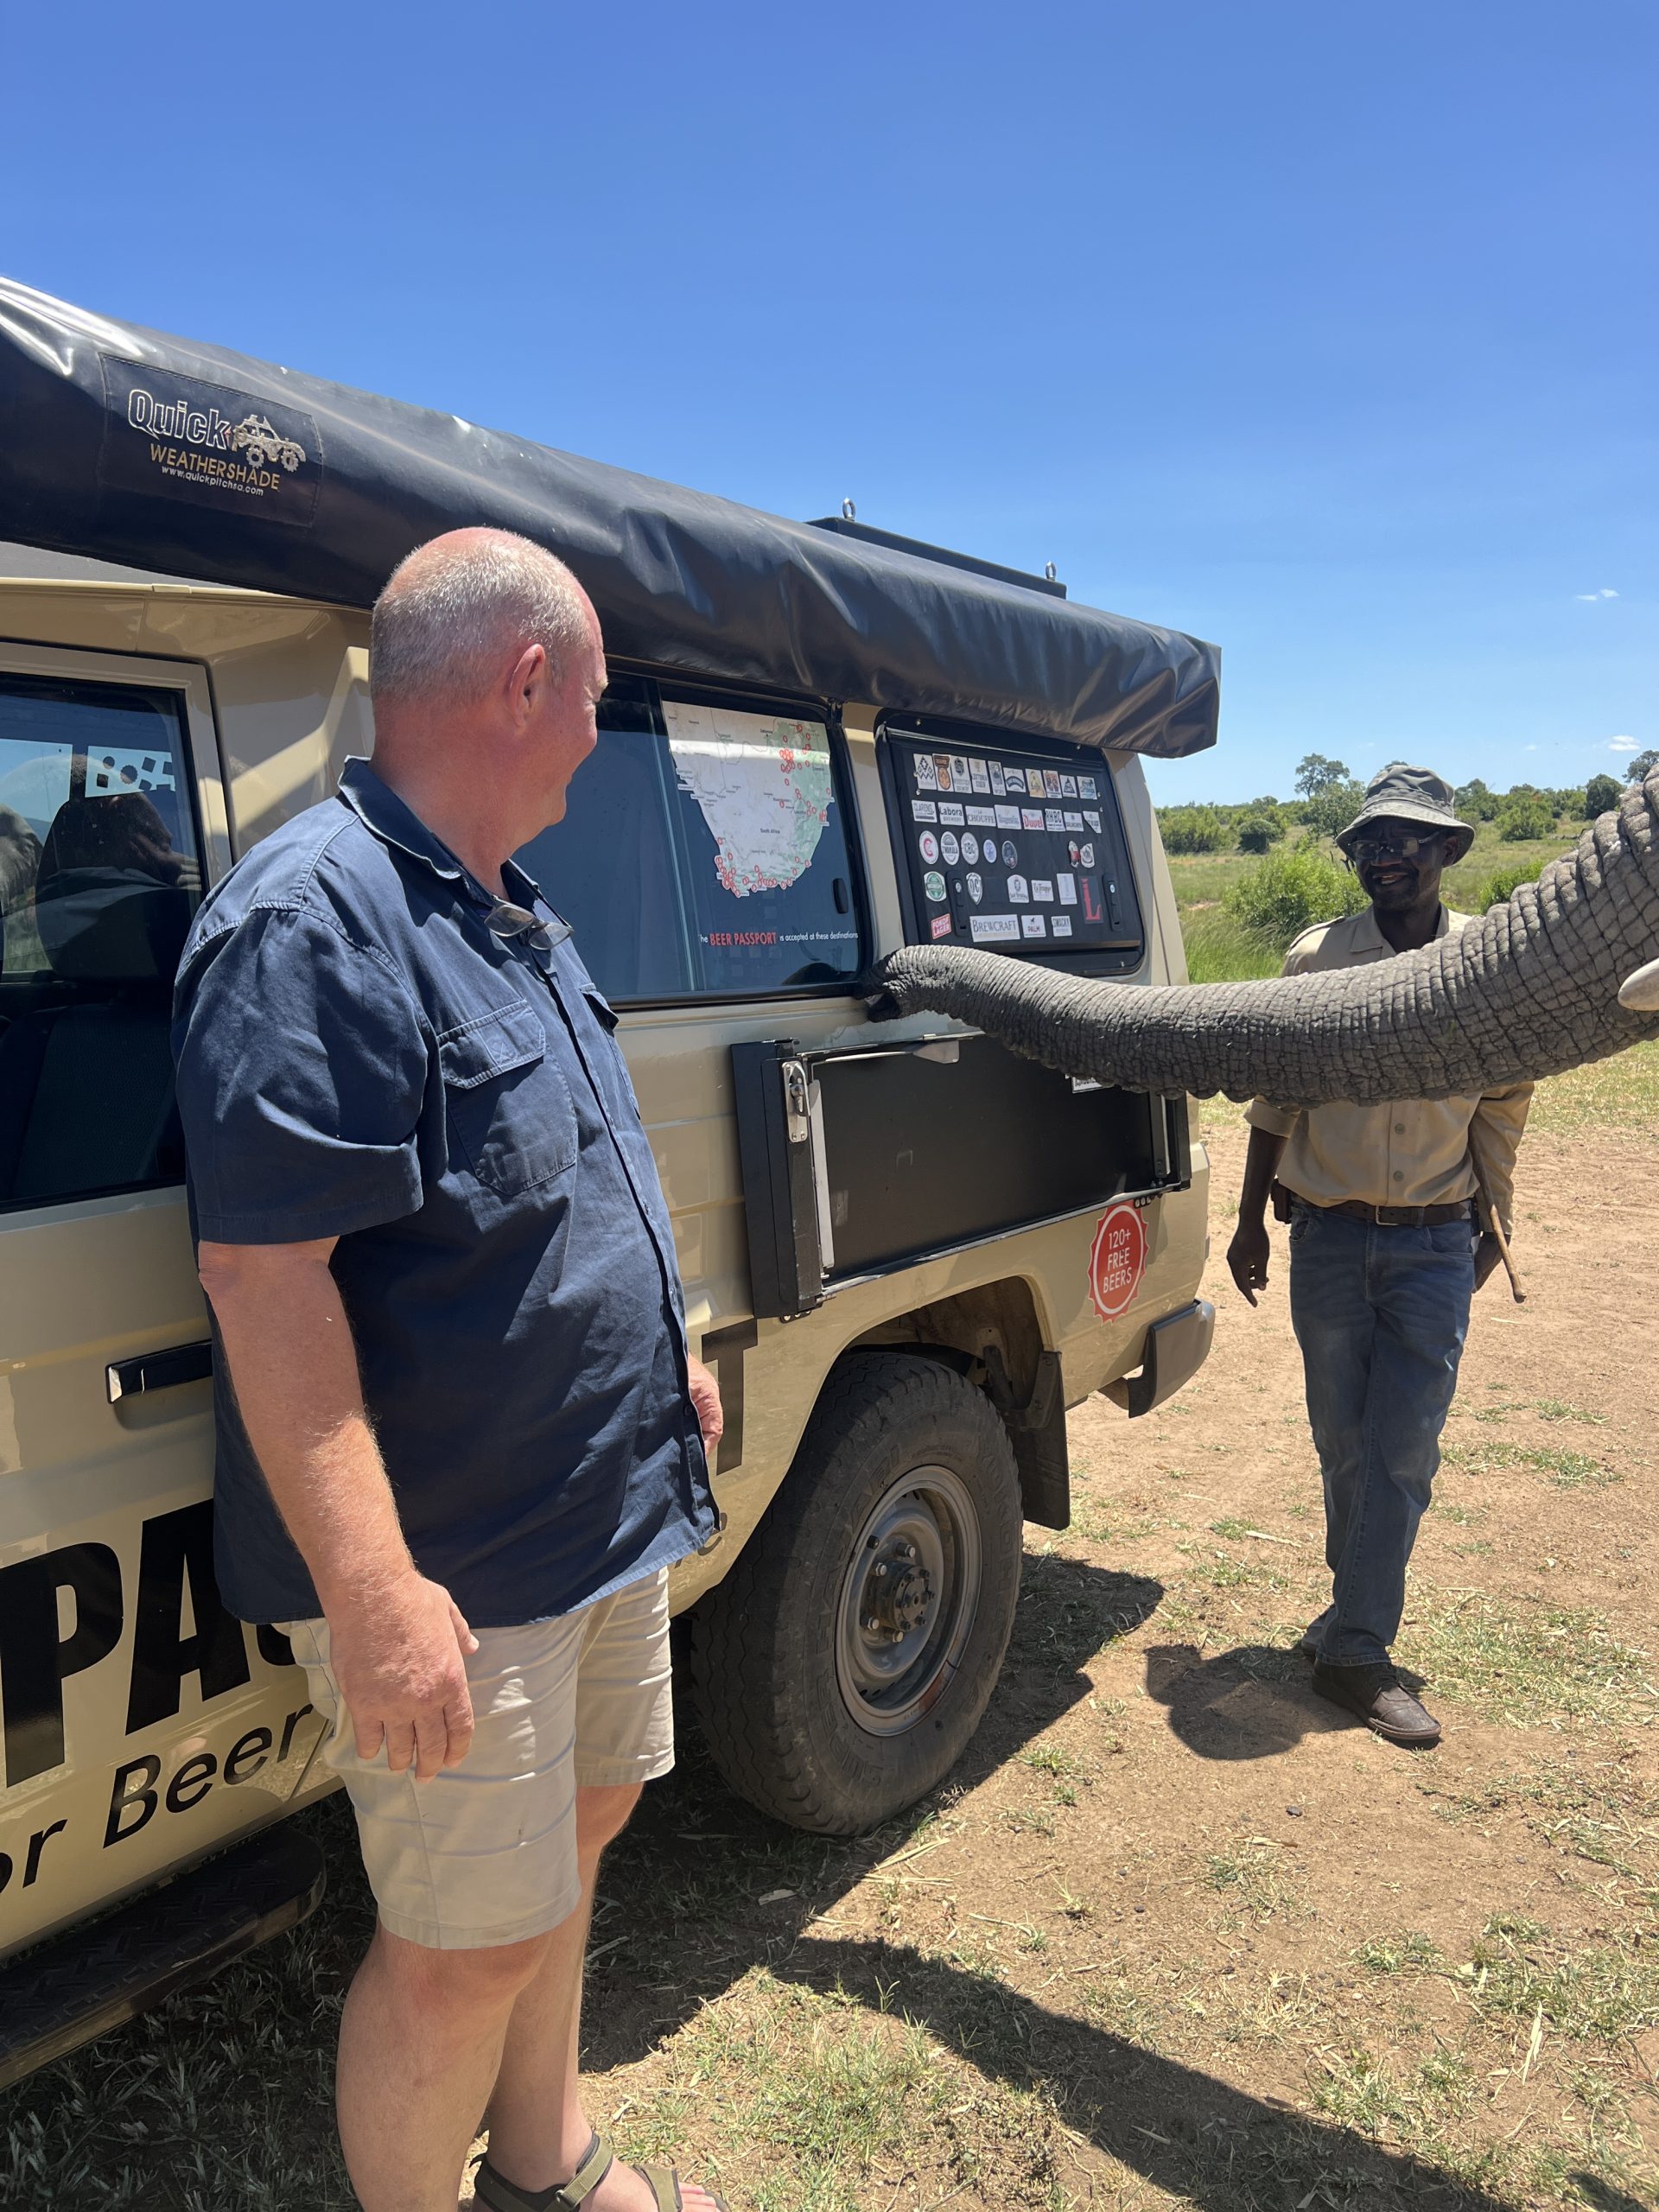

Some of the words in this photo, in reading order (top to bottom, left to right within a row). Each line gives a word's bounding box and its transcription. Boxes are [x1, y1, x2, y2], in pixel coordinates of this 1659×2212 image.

[128, 390, 231, 450] Quick
[150, 443, 280, 490] WEATHERSHADE
[938, 806, 963, 817] Labora
[967, 814, 995, 823] CHOUFFE
[1023, 815, 1043, 828] Duvel
[972, 919, 1016, 933] BREWCRAFT
[709, 932, 731, 946] BEER
[734, 931, 777, 945] PASSPORT
[785, 932, 808, 943] accepted
[809, 932, 815, 941] at
[816, 931, 829, 940] these
[830, 931, 858, 940] destinations
[1108, 1228, 1131, 1249] 120+
[1107, 1247, 1130, 1272] FREE
[1103, 1267, 1132, 1294] BEERS
[103, 1703, 314, 1849] Beer
